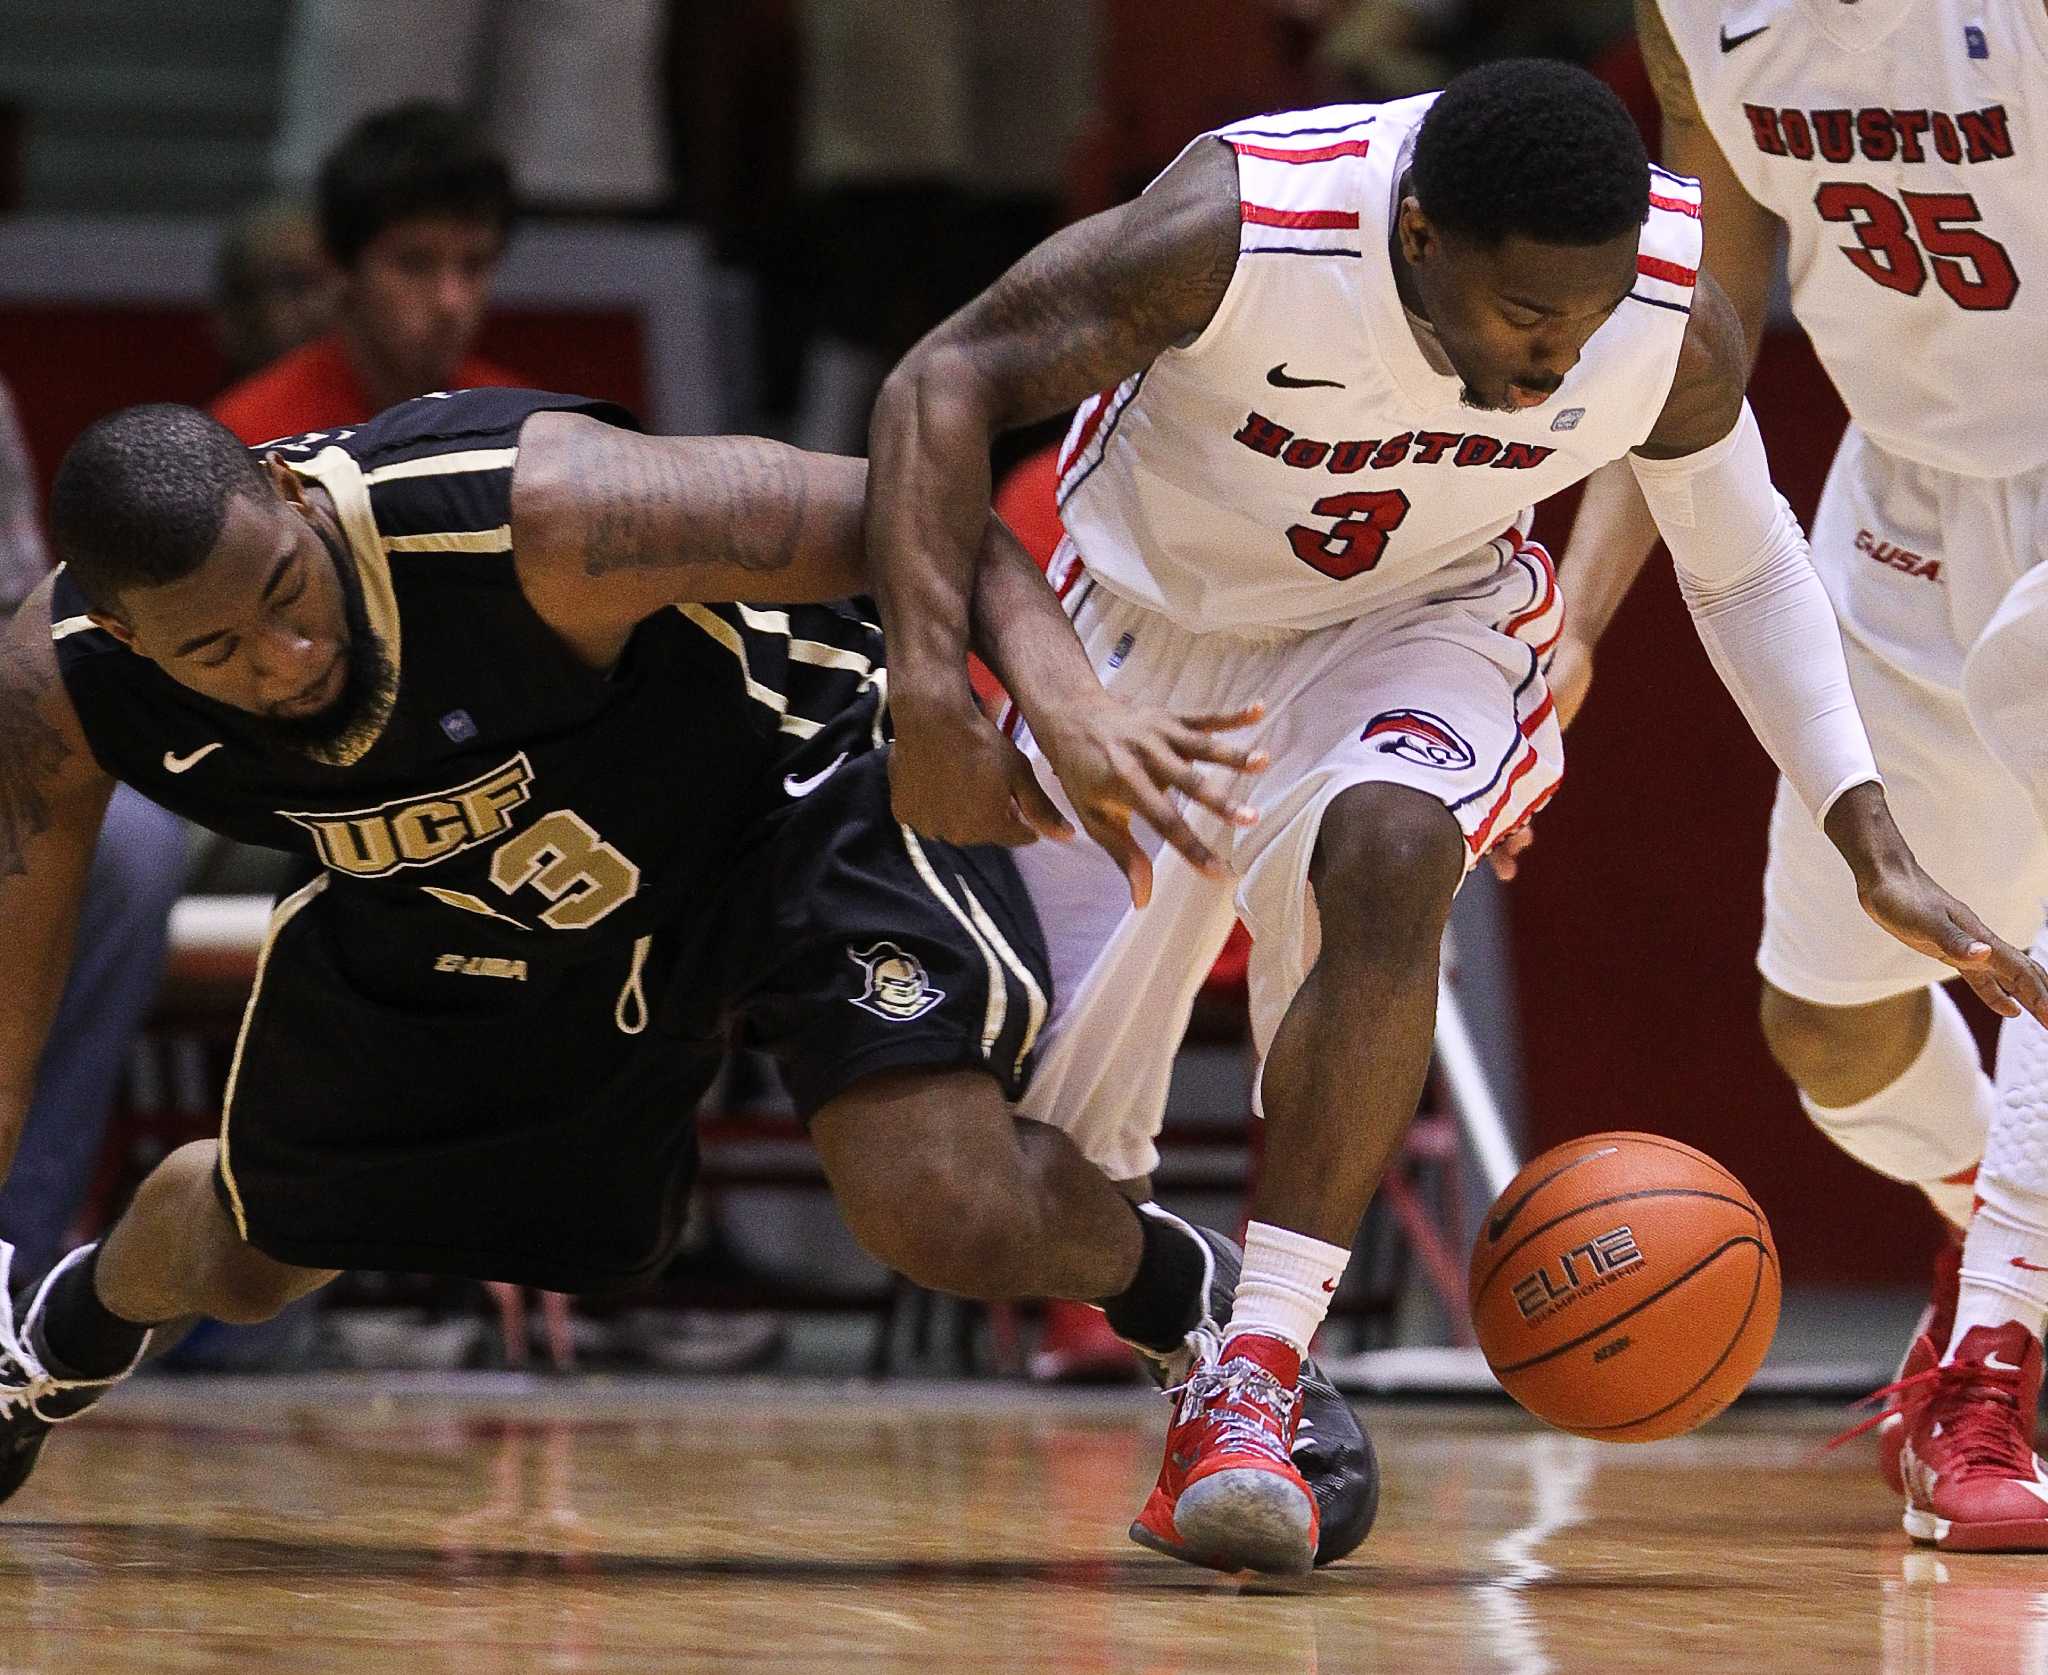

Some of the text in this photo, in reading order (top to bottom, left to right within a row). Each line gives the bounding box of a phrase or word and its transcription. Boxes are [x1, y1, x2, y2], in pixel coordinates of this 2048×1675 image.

[1742, 102, 2015, 165] HOUSTON
[1813, 180, 2021, 311] 35
[1233, 410, 1557, 475] HOUSTON
[1284, 488, 1411, 582] 3
[274, 750, 536, 879] UCF
[488, 809, 641, 929] 3
[1511, 1225, 1644, 1319] ELITE
